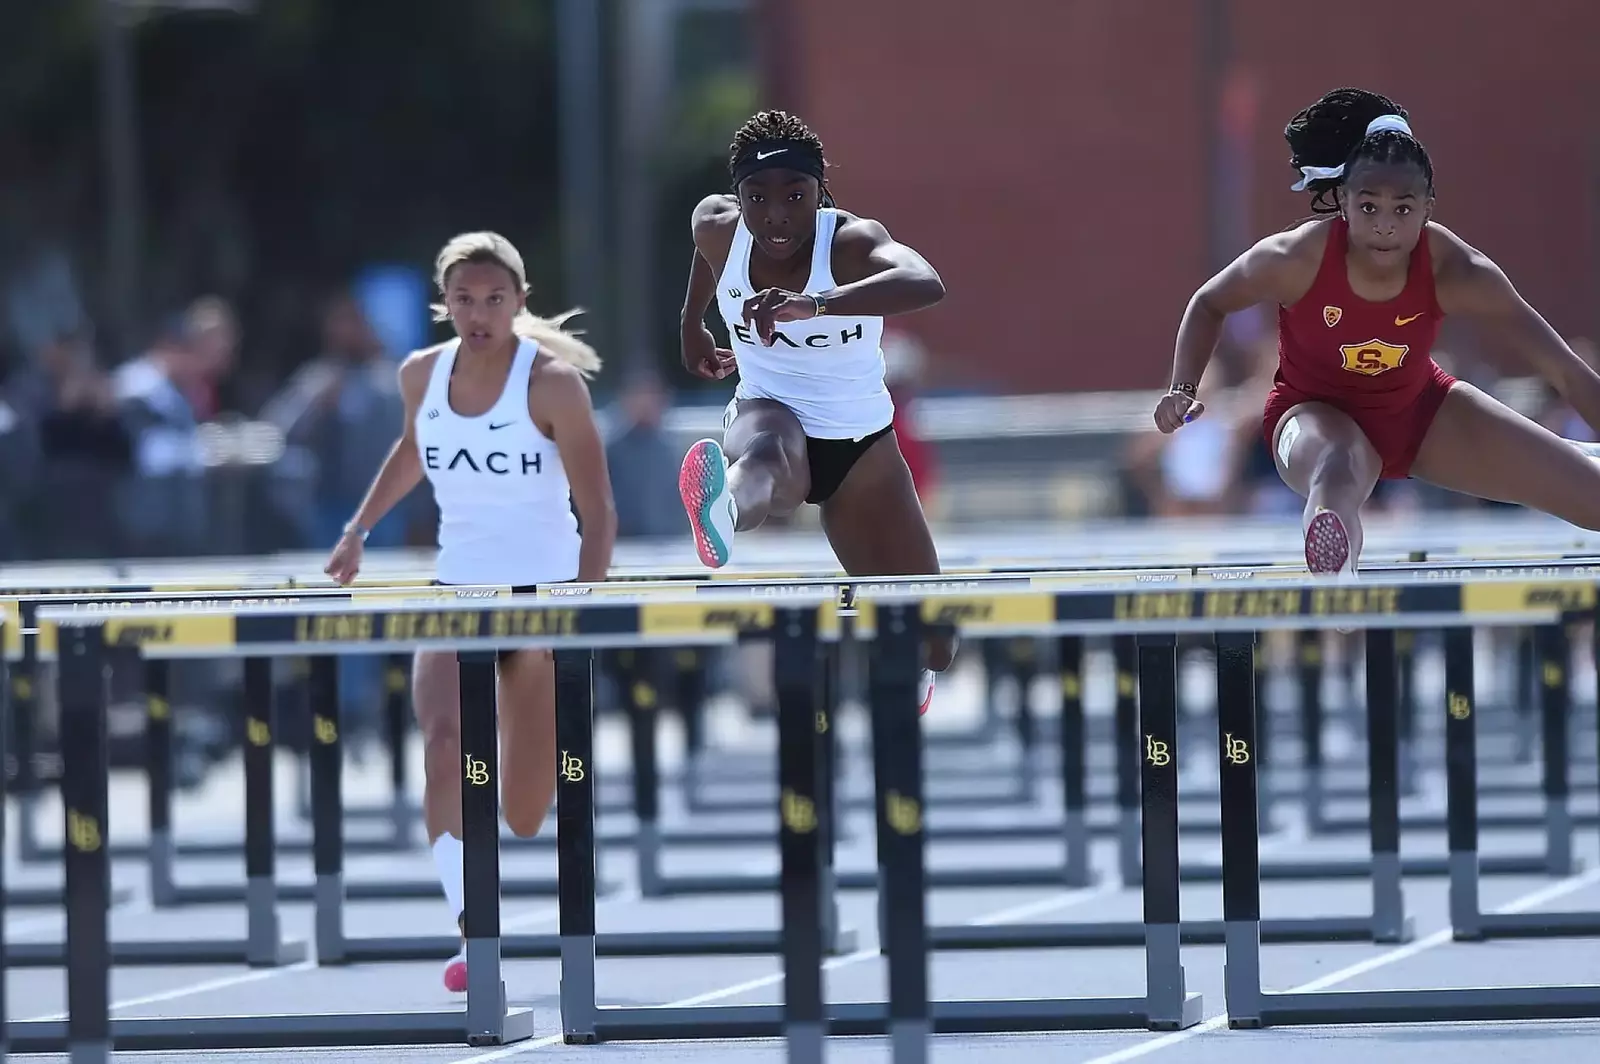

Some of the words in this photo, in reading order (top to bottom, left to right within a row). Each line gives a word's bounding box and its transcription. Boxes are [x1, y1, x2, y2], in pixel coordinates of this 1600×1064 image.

[426, 446, 542, 476] EACH
[1146, 734, 1170, 765] LB
[1226, 733, 1250, 764] LB
[465, 753, 490, 785] LB
[560, 750, 585, 782] LB
